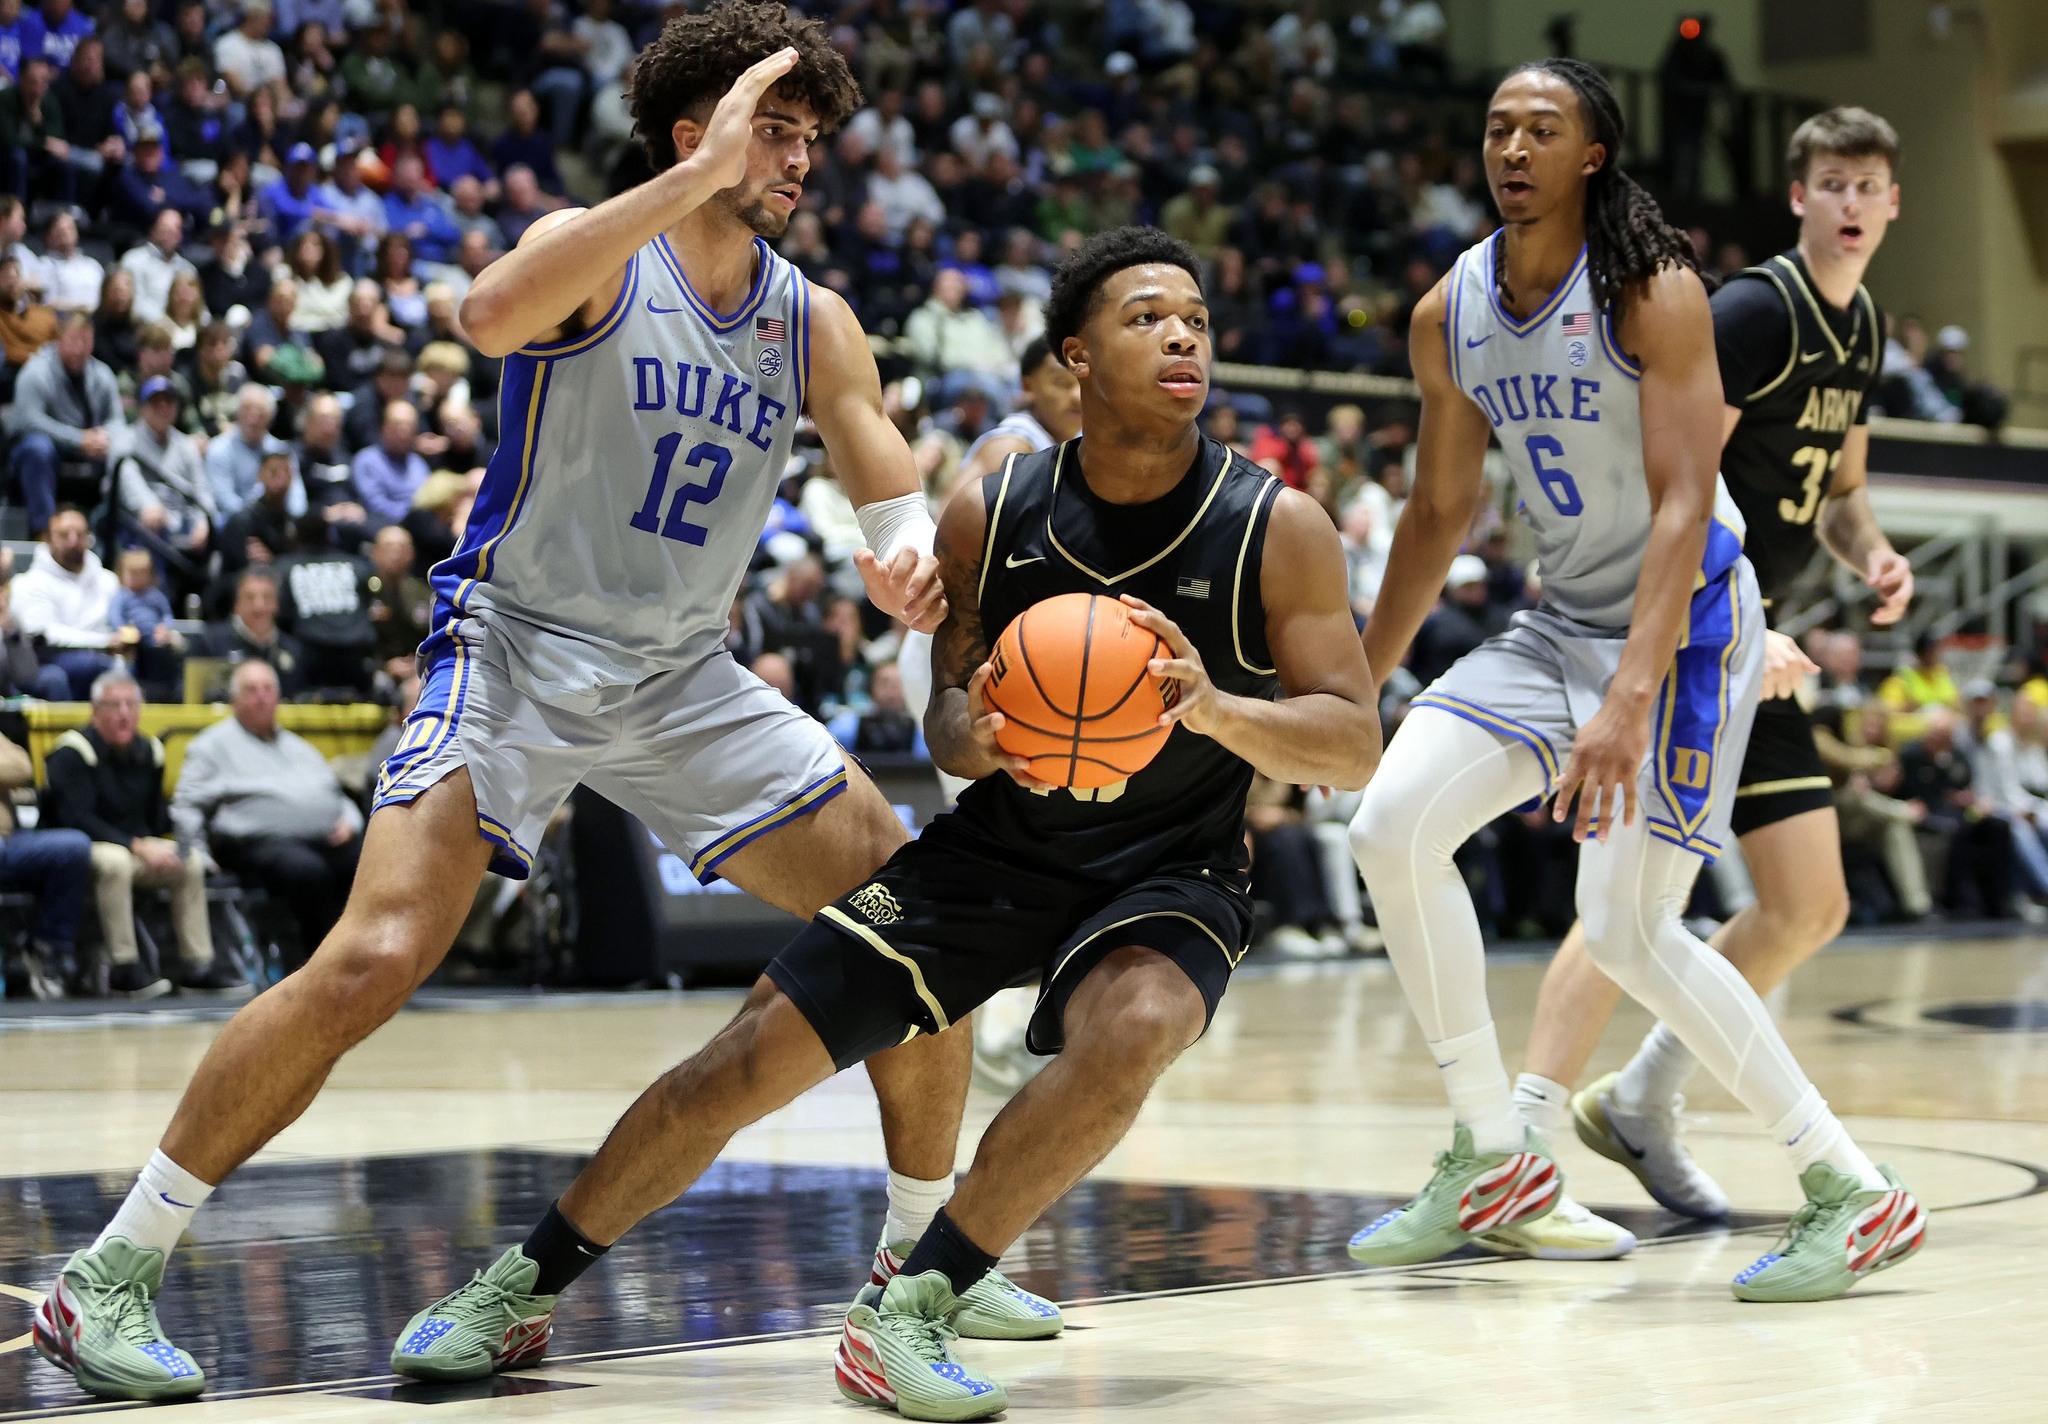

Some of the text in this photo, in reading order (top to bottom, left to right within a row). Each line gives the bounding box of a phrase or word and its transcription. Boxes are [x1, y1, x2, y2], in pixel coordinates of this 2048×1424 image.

[633, 357, 786, 452] DUKE
[1472, 374, 1600, 427] DUKE
[1796, 386, 1863, 432] ARMY
[629, 432, 734, 547] 12
[1525, 434, 1584, 516] 6
[1778, 446, 1842, 525] 3
[1670, 746, 1710, 789] D
[855, 889, 899, 924] PATRIOT
